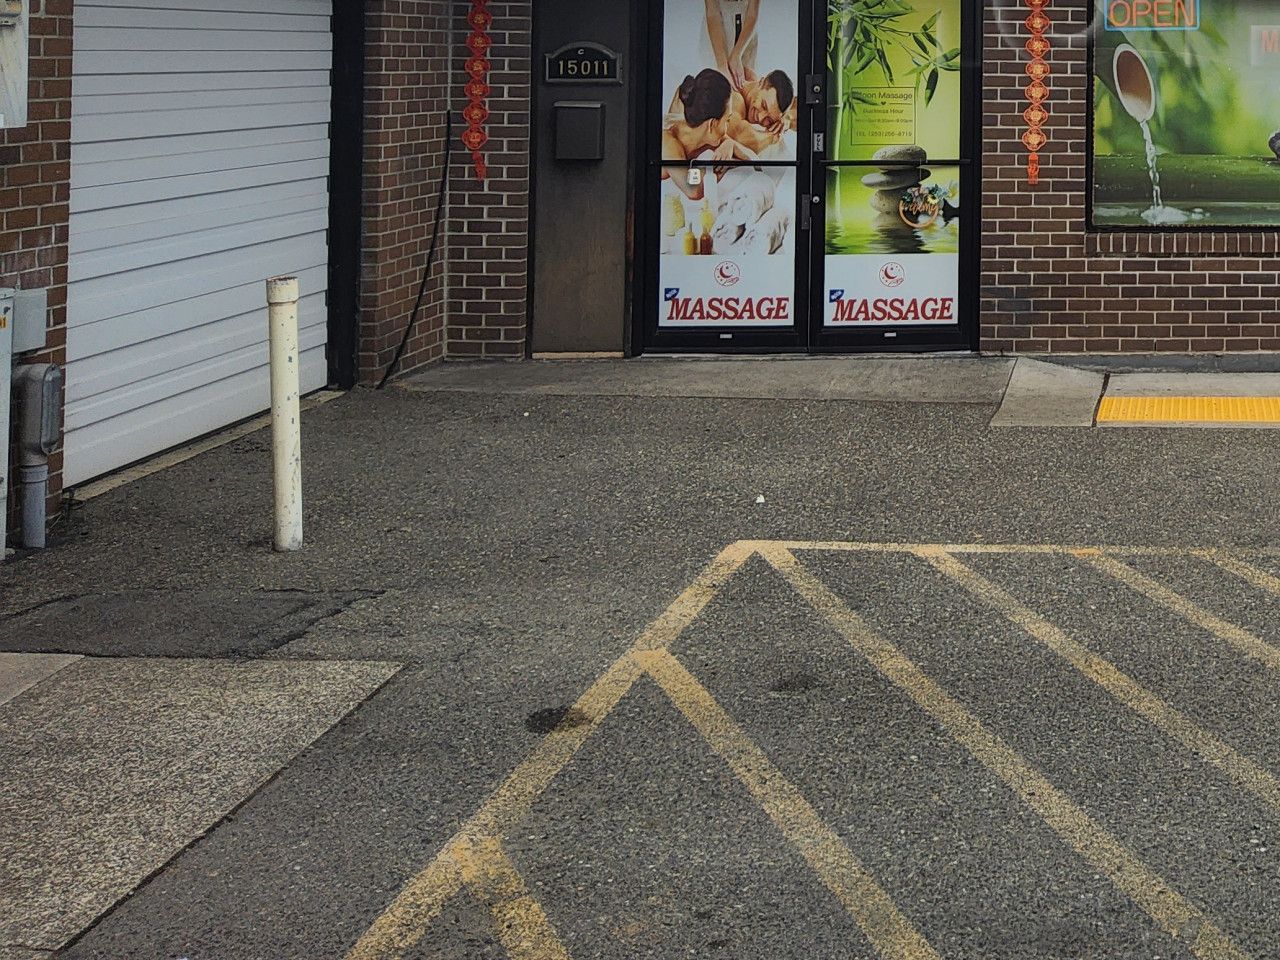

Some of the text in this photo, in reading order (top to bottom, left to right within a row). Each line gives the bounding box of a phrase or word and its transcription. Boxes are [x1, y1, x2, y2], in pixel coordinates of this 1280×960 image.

[1108, 0, 1195, 27] OPEN
[559, 60, 608, 76] 15011
[667, 297, 790, 320] MASSAGE
[832, 297, 954, 321] MASSAGE
